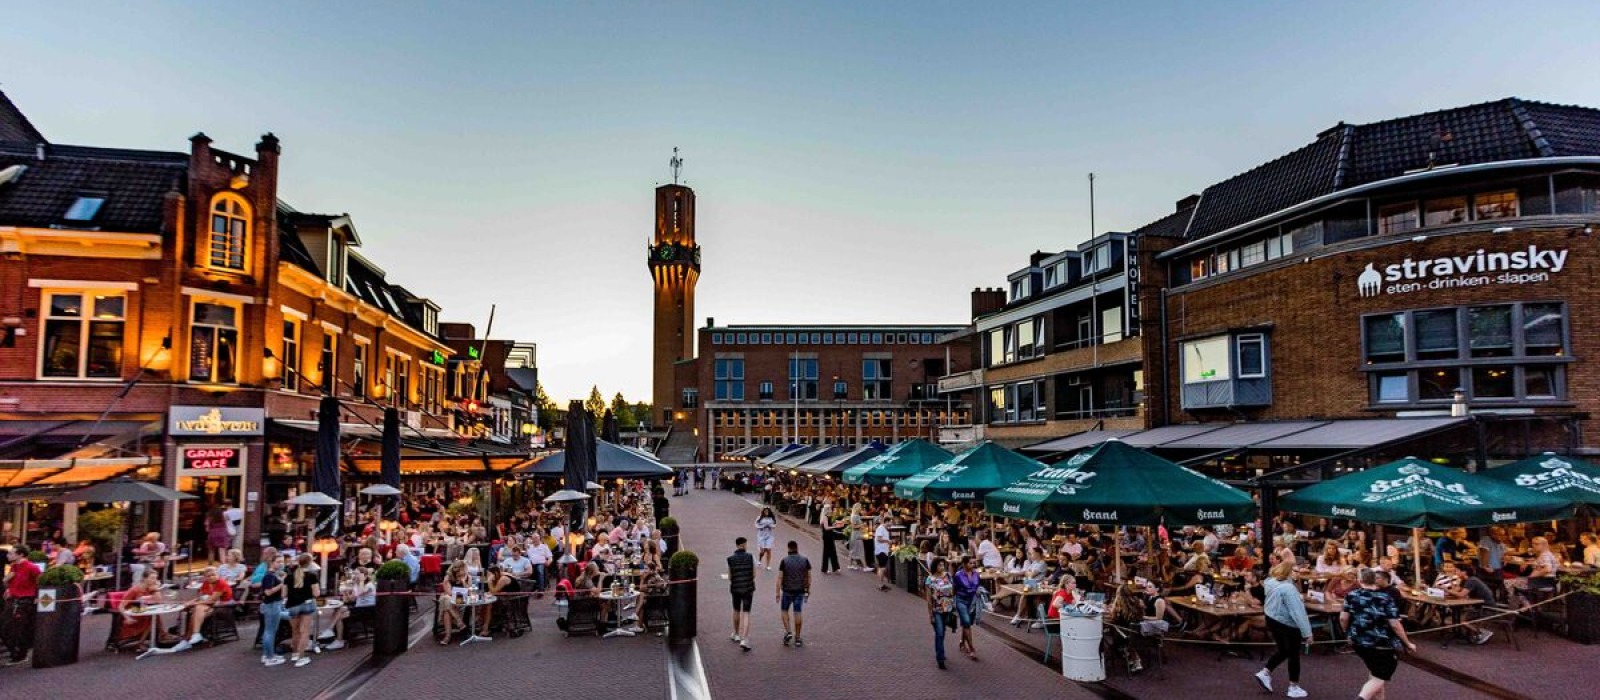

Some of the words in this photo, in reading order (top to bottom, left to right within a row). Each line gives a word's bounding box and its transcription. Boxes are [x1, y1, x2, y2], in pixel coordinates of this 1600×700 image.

[1385, 245, 1569, 282] stravinsky
[1128, 255, 1138, 318] HOTEL
[1386, 282, 1421, 295] eten
[1428, 272, 1490, 290] drinken
[1497, 271, 1549, 285] slapen
[186, 448, 235, 458] GRAND
[191, 458, 228, 469] CAFÉ
[1370, 473, 1469, 495] Brand
[1082, 508, 1118, 521] Brand
[1197, 508, 1225, 521] Brand
